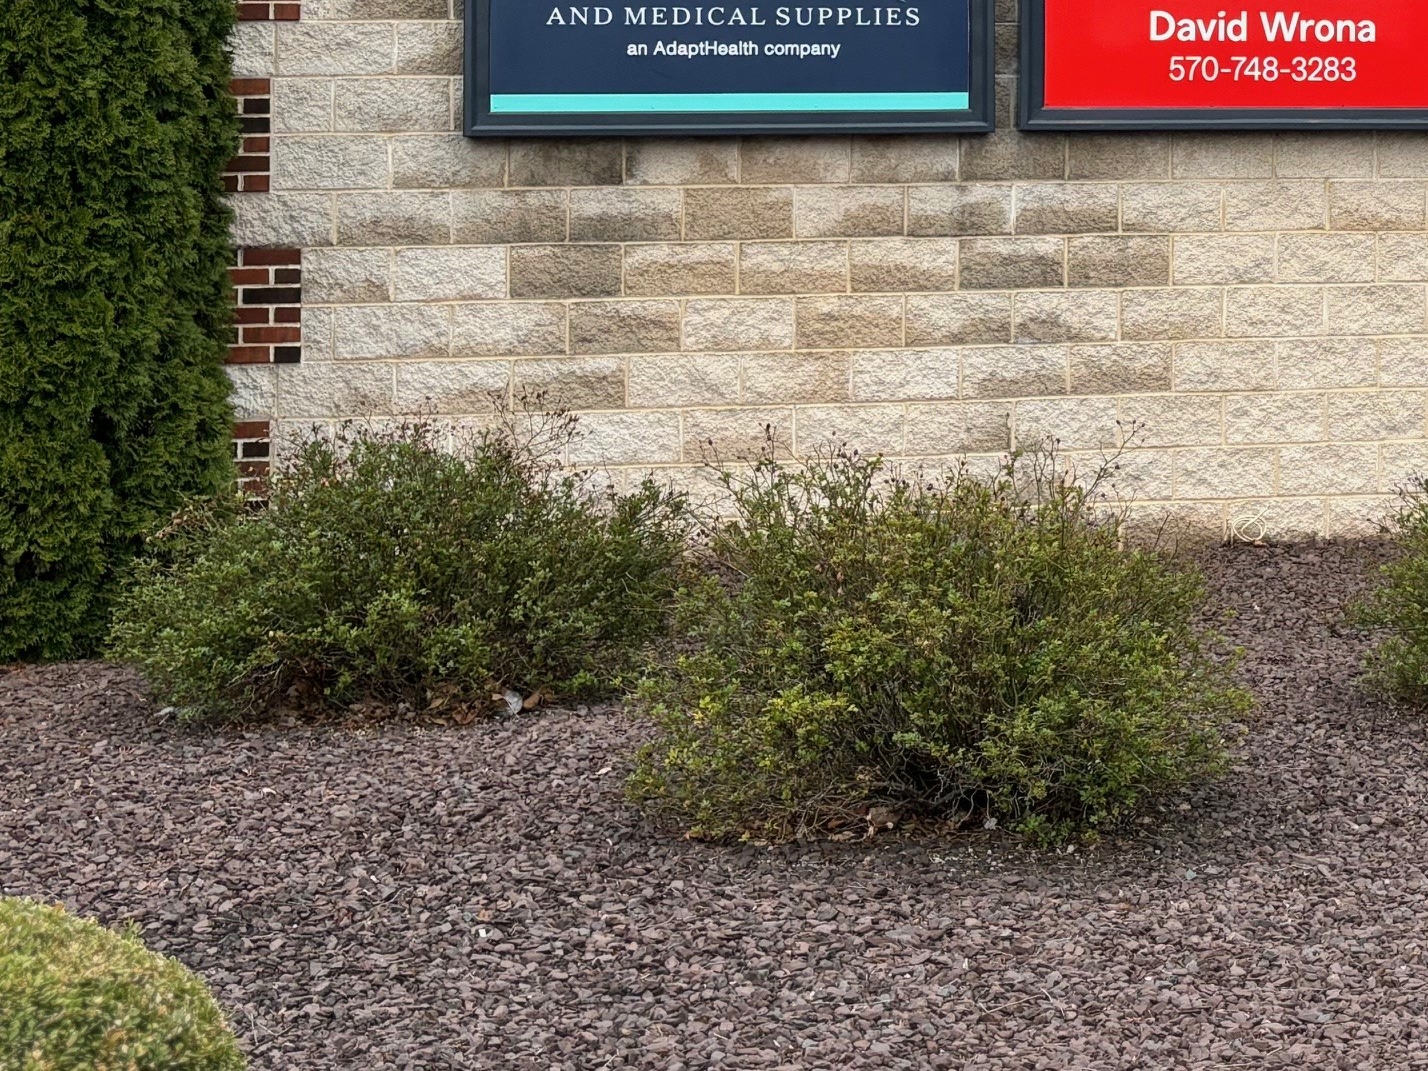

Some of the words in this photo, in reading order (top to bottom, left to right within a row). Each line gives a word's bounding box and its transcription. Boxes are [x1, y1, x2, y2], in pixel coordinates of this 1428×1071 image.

[545, 6, 613, 26] AND
[624, 6, 766, 26] MEDICAL
[775, 6, 920, 26] SUPPLIES
[1149, 10, 1248, 42] David
[1259, 11, 1376, 43] Wrona
[626, 43, 648, 56] an
[652, 40, 759, 59] AdaptHealth
[764, 43, 841, 59] company
[1168, 55, 1357, 82] 570-748-3283
